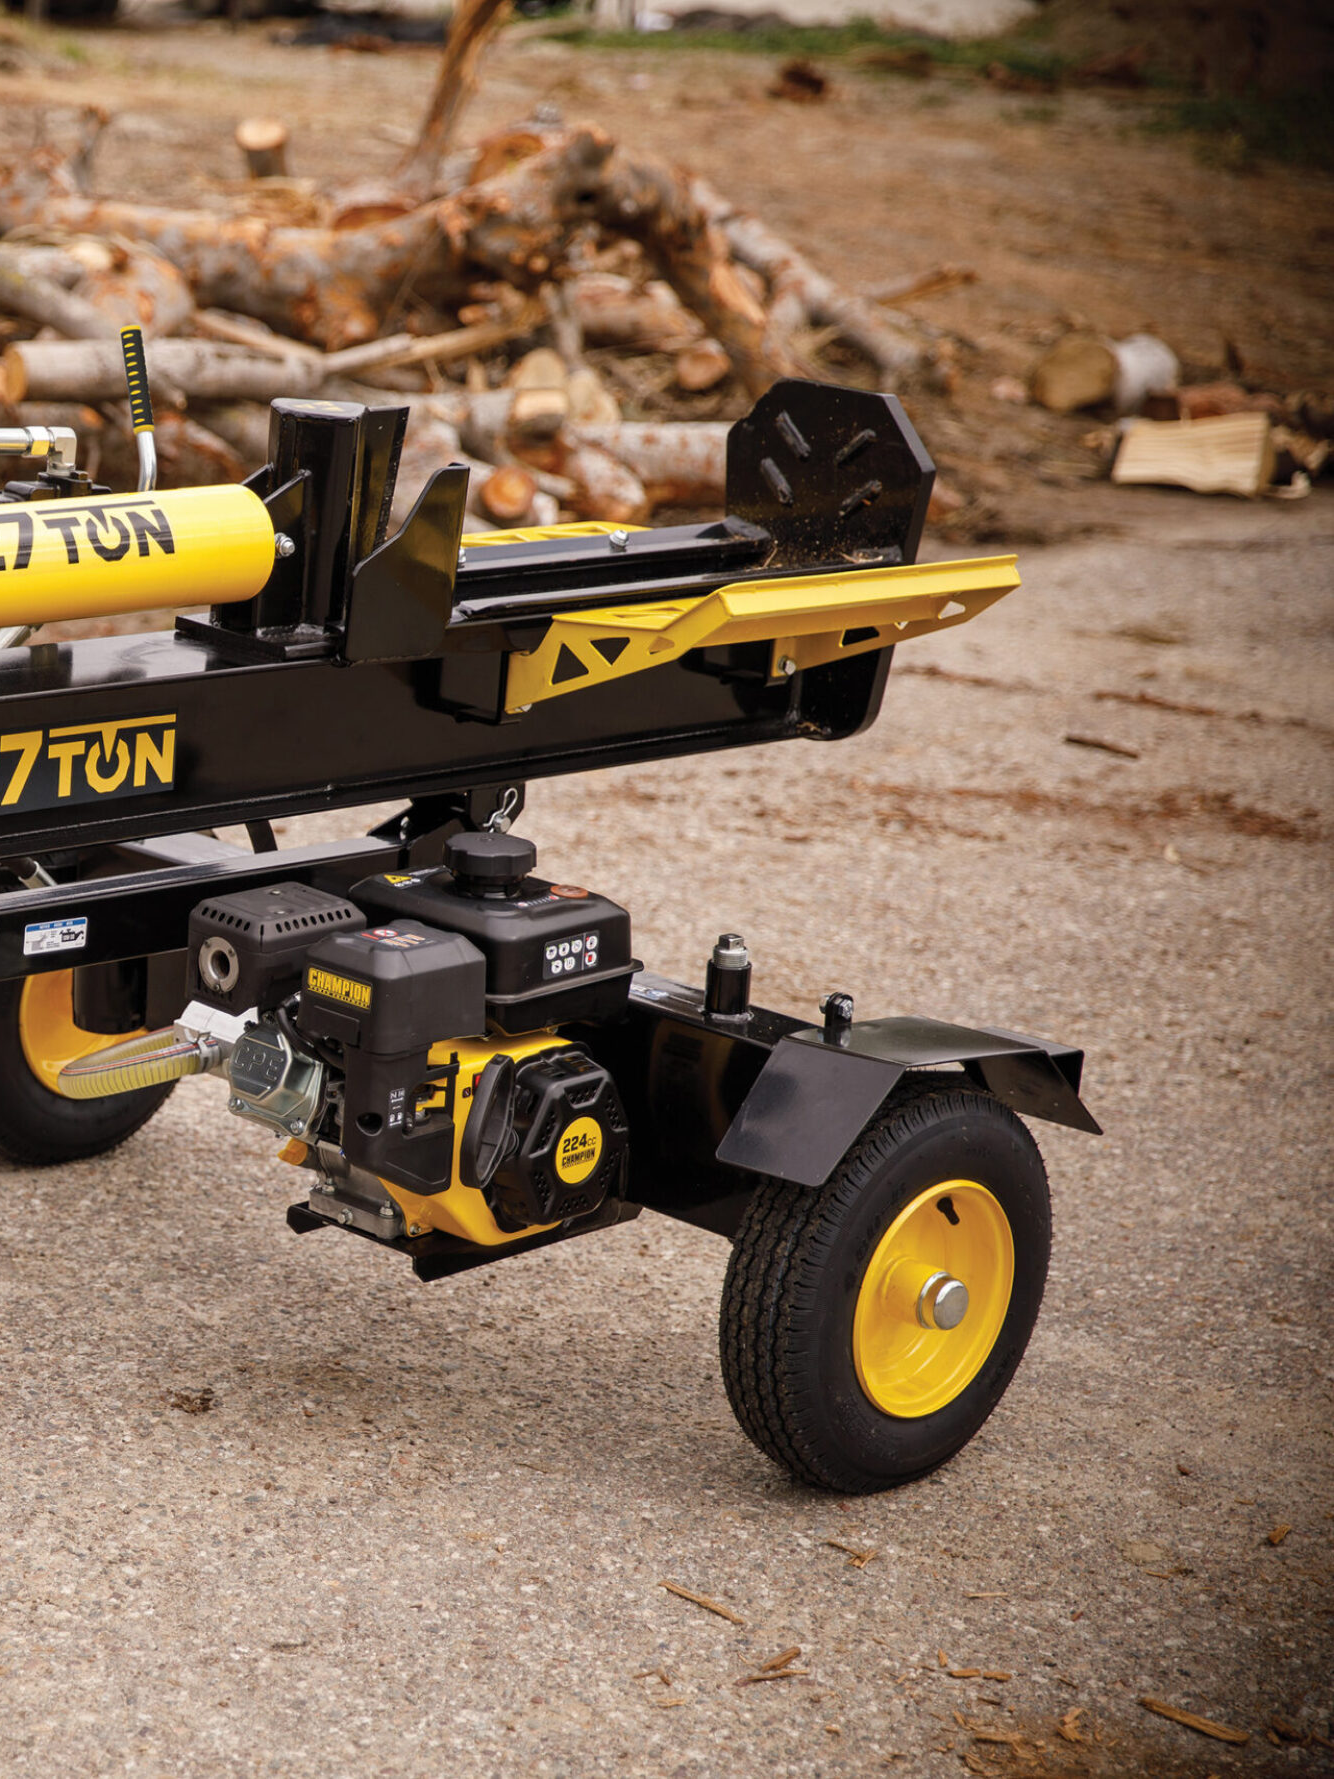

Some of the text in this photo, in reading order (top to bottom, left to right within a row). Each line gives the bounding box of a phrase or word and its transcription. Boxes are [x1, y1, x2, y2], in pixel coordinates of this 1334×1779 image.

[35, 500, 176, 565] TON
[47, 713, 177, 798] TON
[308, 968, 372, 1004] CHAMPION
[562, 1147, 596, 1167] CHAMPION
